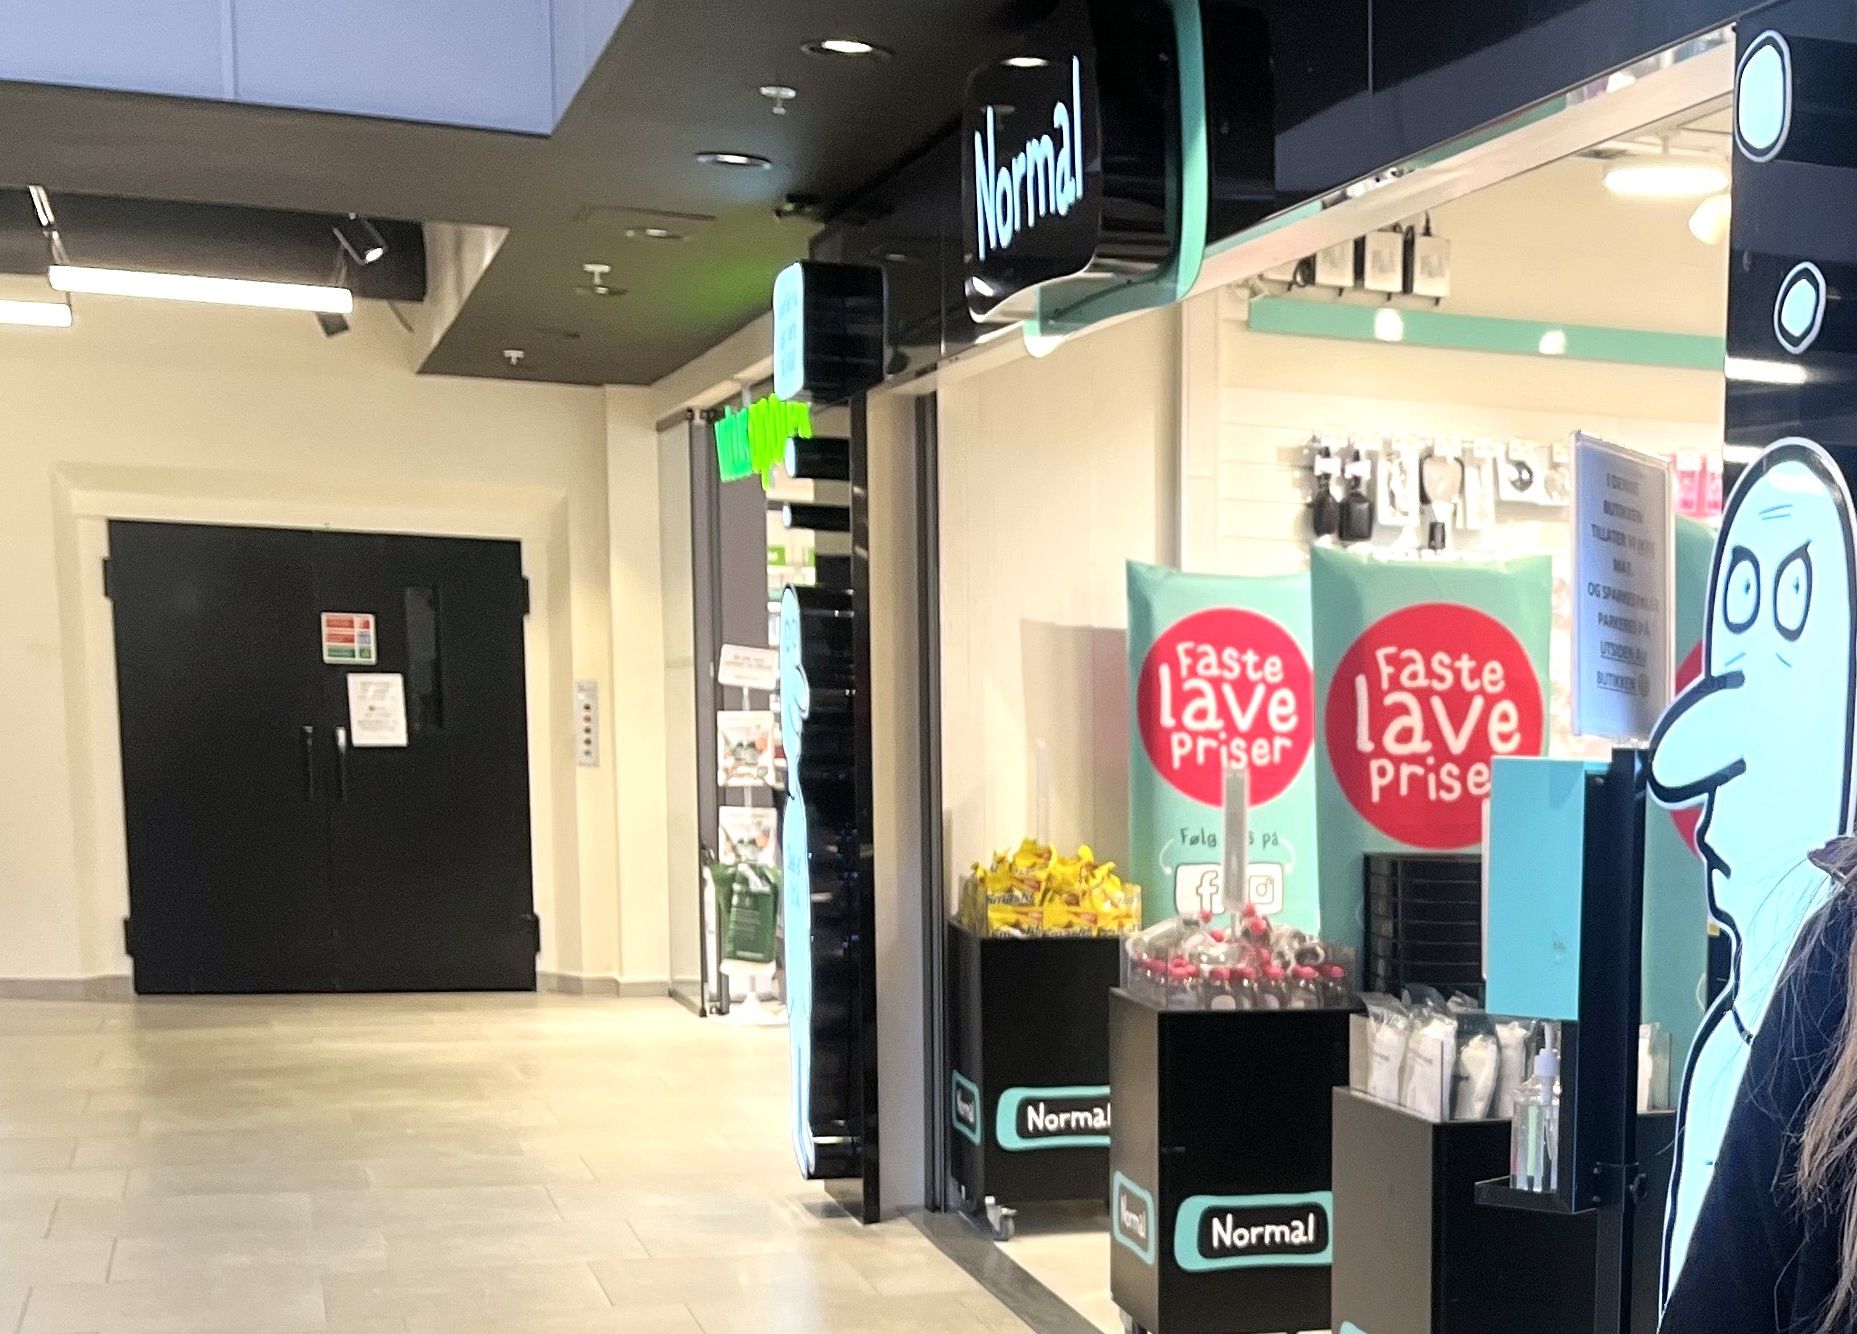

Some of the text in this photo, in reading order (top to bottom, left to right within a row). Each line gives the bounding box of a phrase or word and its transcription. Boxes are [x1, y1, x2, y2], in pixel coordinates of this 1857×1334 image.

[974, 55, 1084, 262] Normal
[1176, 641, 1285, 683] Faste
[1375, 646, 1506, 694] Faste
[1158, 663, 1299, 733] lave
[1354, 674, 1522, 756] lave
[1170, 730, 1294, 770] priser
[1211, 1212, 1315, 1249] Normal
